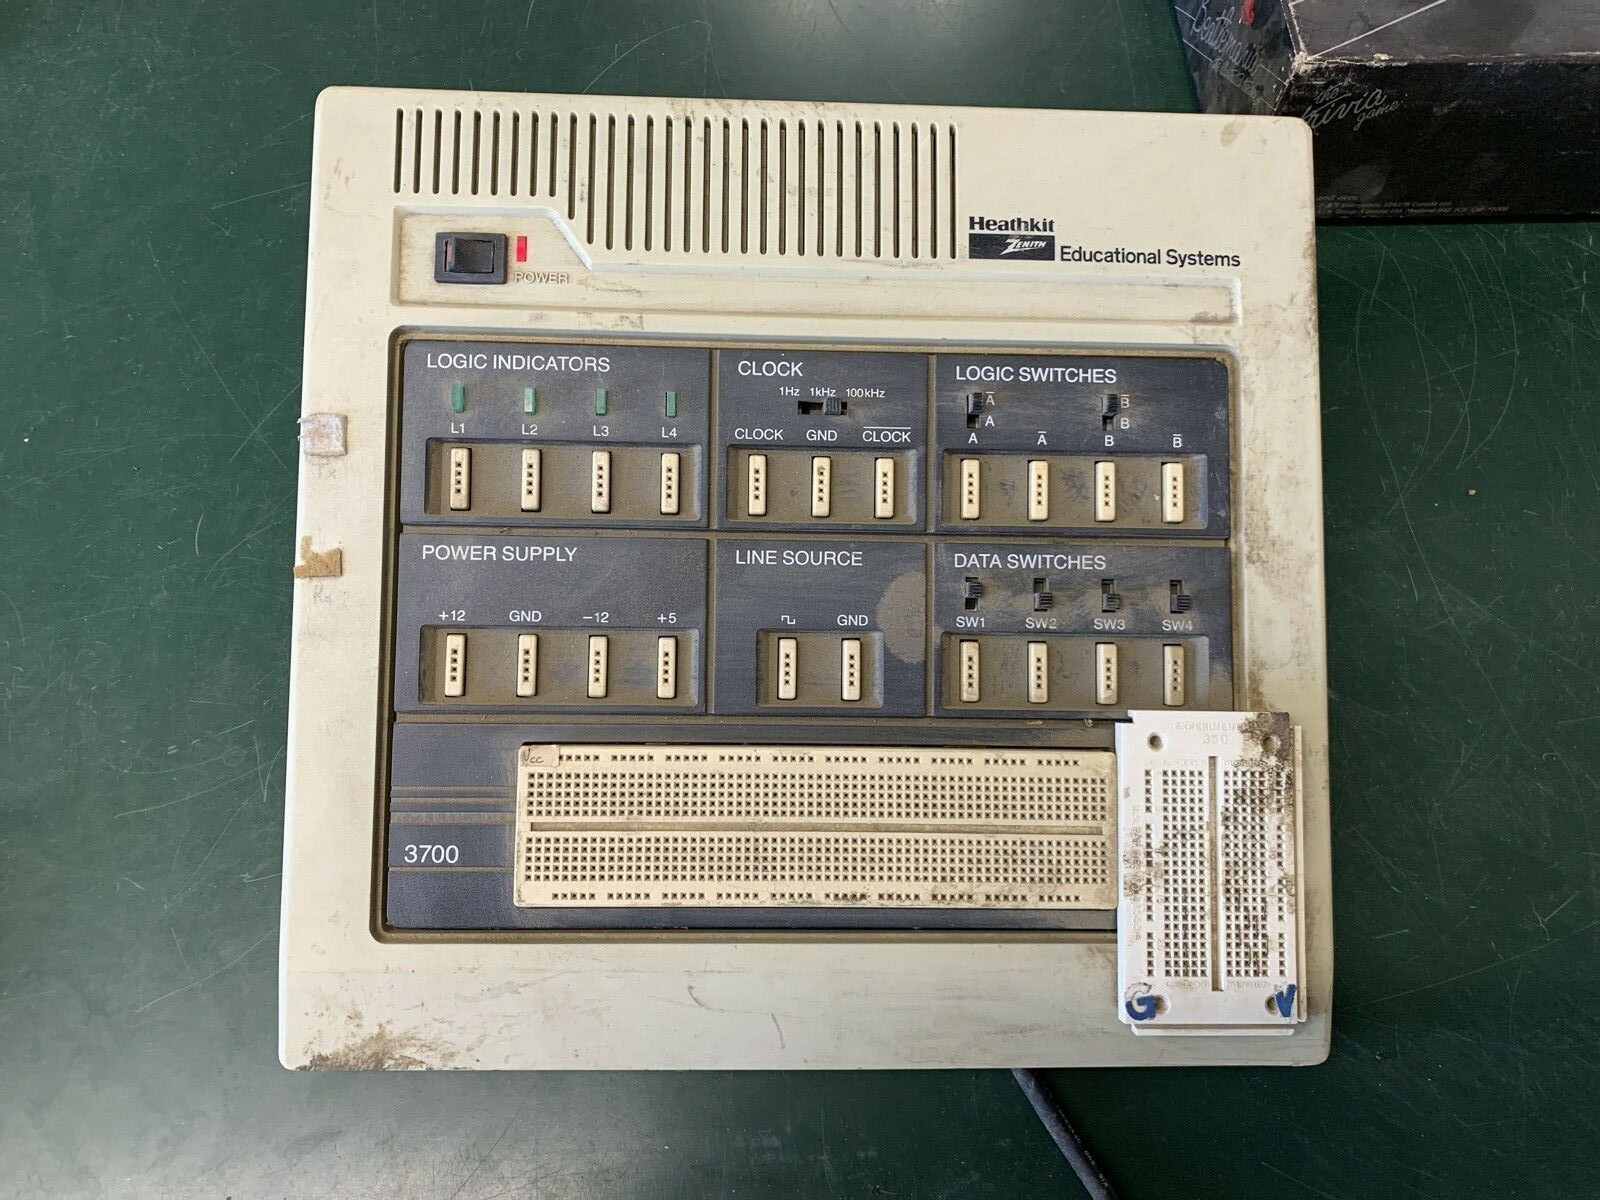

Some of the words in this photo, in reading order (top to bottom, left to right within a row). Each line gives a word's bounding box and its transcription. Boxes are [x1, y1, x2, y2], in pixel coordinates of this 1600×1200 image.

[969, 215, 1055, 233] Heathkit
[999, 238, 1048, 256] ZENITH
[1060, 245, 1161, 265] Educational
[1166, 248, 1241, 268] Systems
[514, 271, 569, 284] POWER
[427, 353, 487, 370] LOGIC
[493, 355, 611, 373] INDICATORS
[738, 360, 803, 377] CLOCK
[956, 365, 1014, 382] LOGIC
[1018, 367, 1117, 384] SWITCHES
[779, 386, 800, 397] 1Hz
[809, 387, 836, 397] 1kHz
[985, 415, 995, 427] A
[1120, 417, 1130, 429] B
[451, 423, 465, 434] L1
[521, 424, 538, 435] L2
[593, 425, 609, 437] L3
[662, 427, 678, 438] L4
[734, 428, 784, 440] CLOCK
[862, 426, 912, 443] CLOCK
[806, 429, 838, 442] GND
[968, 432, 978, 444] A
[1104, 434, 1115, 447] B
[422, 544, 497, 561] POWER
[502, 546, 577, 562] SUPPLY
[735, 549, 777, 566] LINE
[782, 550, 863, 566] SOURCE
[954, 553, 1002, 569] DATA
[1006, 554, 1107, 570] SWITCHES
[438, 609, 466, 622] +12
[508, 610, 542, 623] GND
[657, 612, 677, 624] +5
[836, 614, 869, 627] GND
[956, 616, 986, 628] SW1
[1025, 617, 1058, 629] SW2
[1093, 618, 1126, 630] SW3
[1162, 619, 1193, 631] SW4
[404, 844, 459, 864] 3700
[1124, 983, 1157, 1021] G
[1274, 984, 1298, 1018] V
